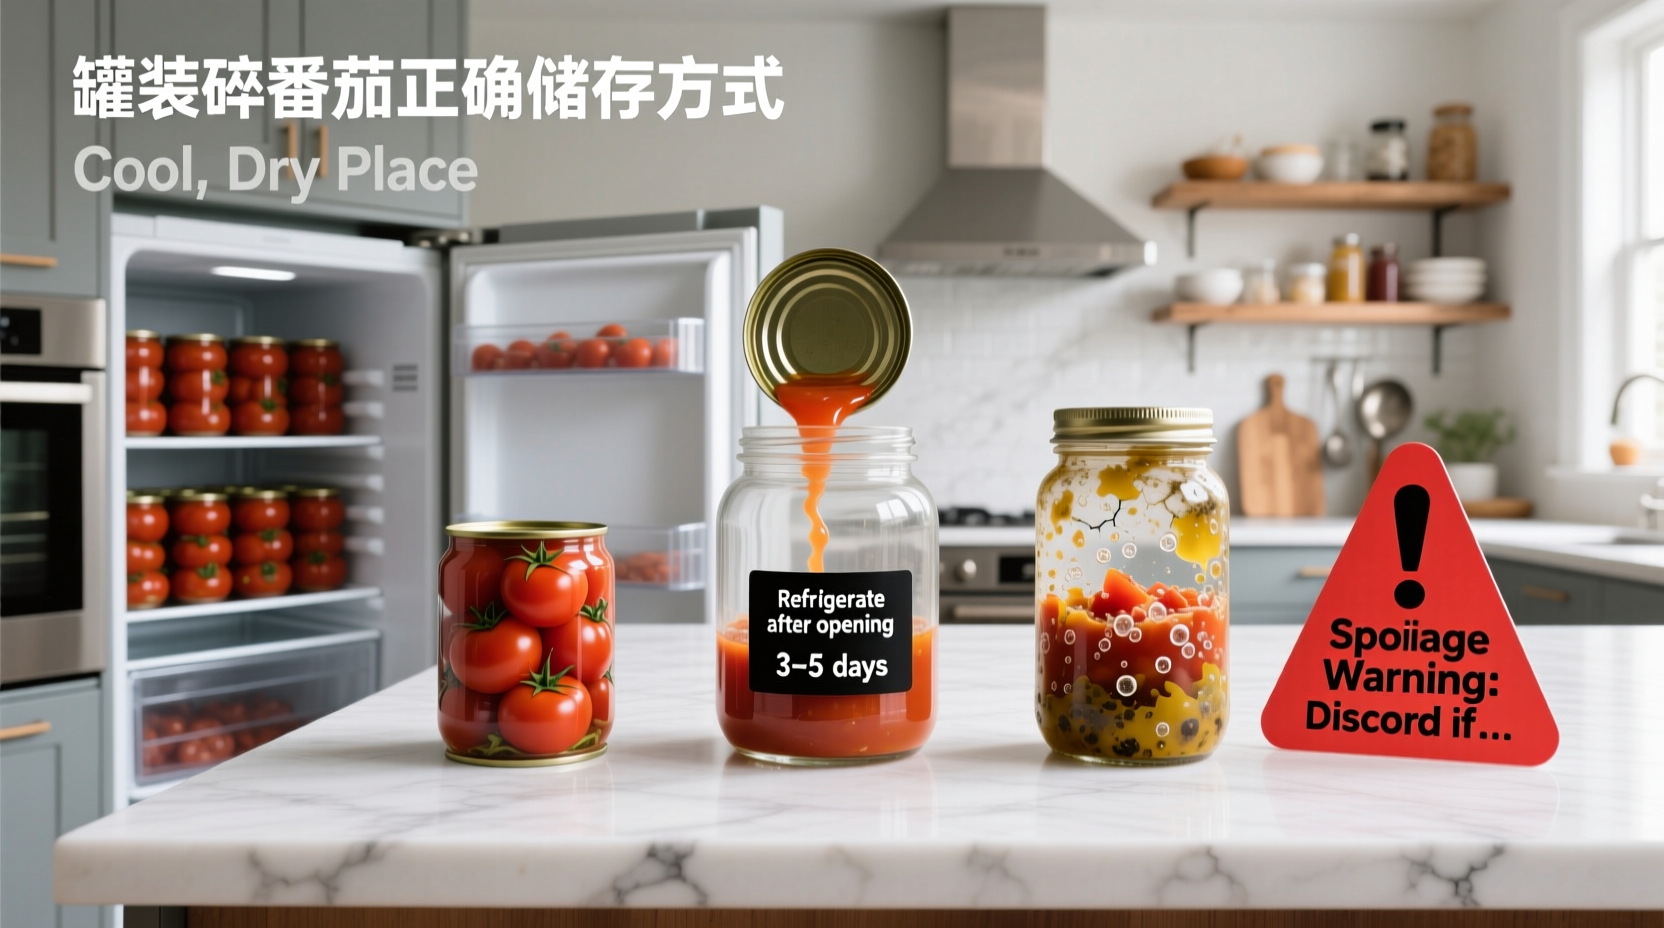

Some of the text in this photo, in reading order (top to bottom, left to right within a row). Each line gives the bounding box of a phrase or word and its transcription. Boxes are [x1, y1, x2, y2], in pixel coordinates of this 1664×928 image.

[778, 588, 886, 614] Refrigerate
[767, 613, 894, 639] after opening
[832, 652, 889, 683] days
[1323, 658, 1499, 704] Warning:
[1305, 700, 1442, 737] Discord
